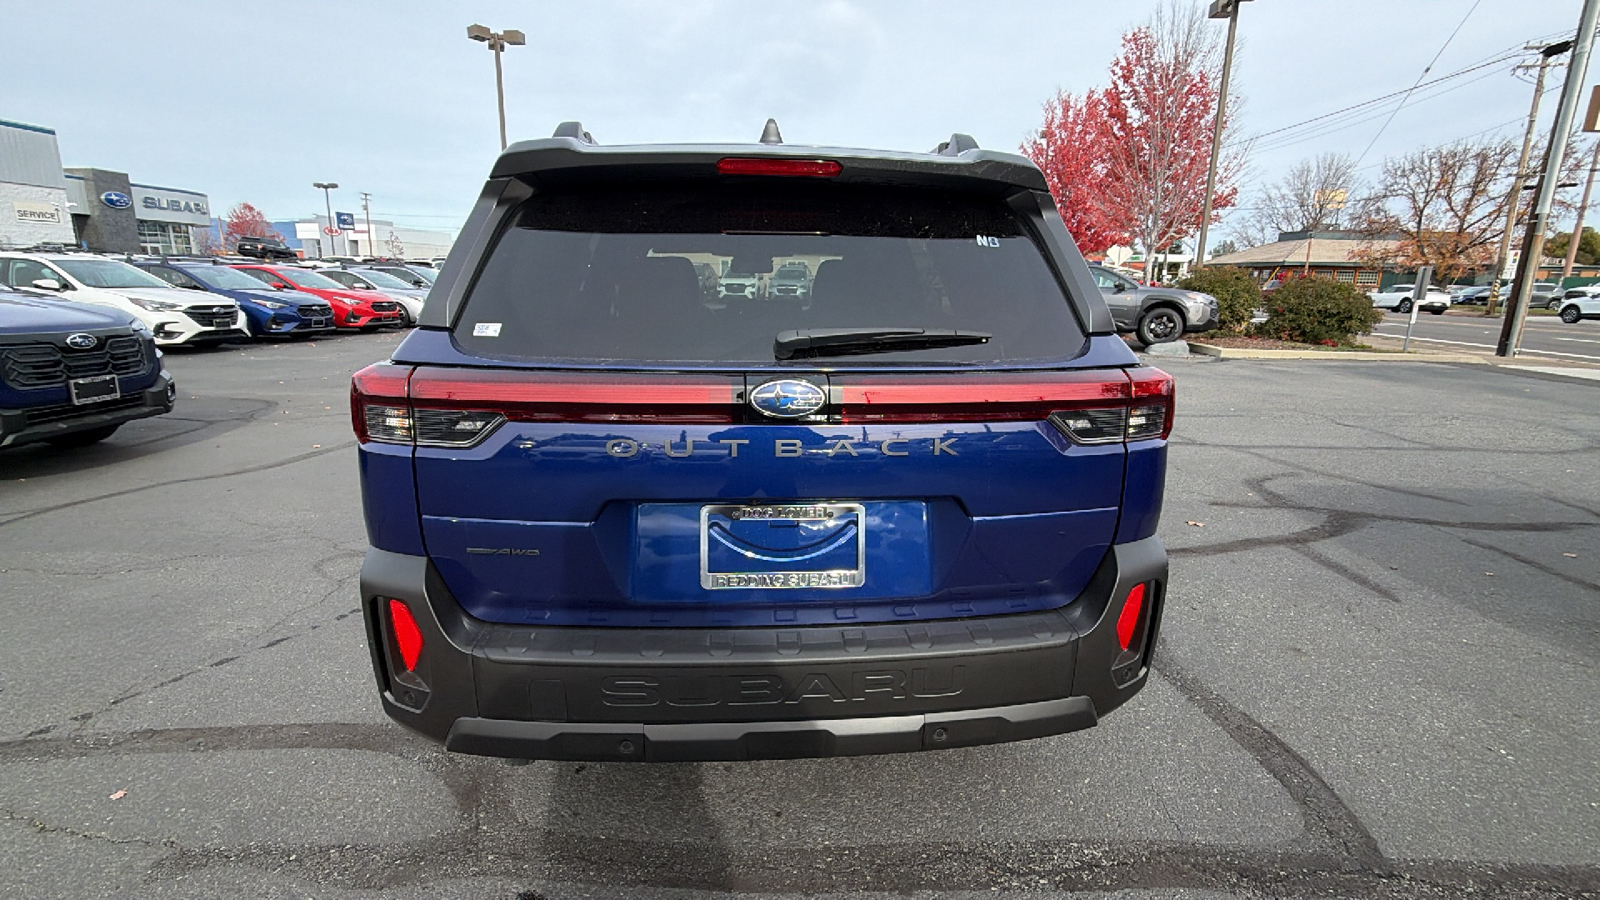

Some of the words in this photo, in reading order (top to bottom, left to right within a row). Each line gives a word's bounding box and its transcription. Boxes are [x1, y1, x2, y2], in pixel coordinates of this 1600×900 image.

[143, 196, 207, 215] SUBARU
[17, 209, 57, 220] SERVICE
[605, 437, 959, 457] OUTBACK
[742, 507, 773, 518] DOG
[778, 507, 825, 518] LOVER
[492, 548, 541, 556] AWD
[716, 574, 784, 587] REDDING
[788, 573, 851, 587] SUBARU
[602, 666, 965, 707] SUBARU
